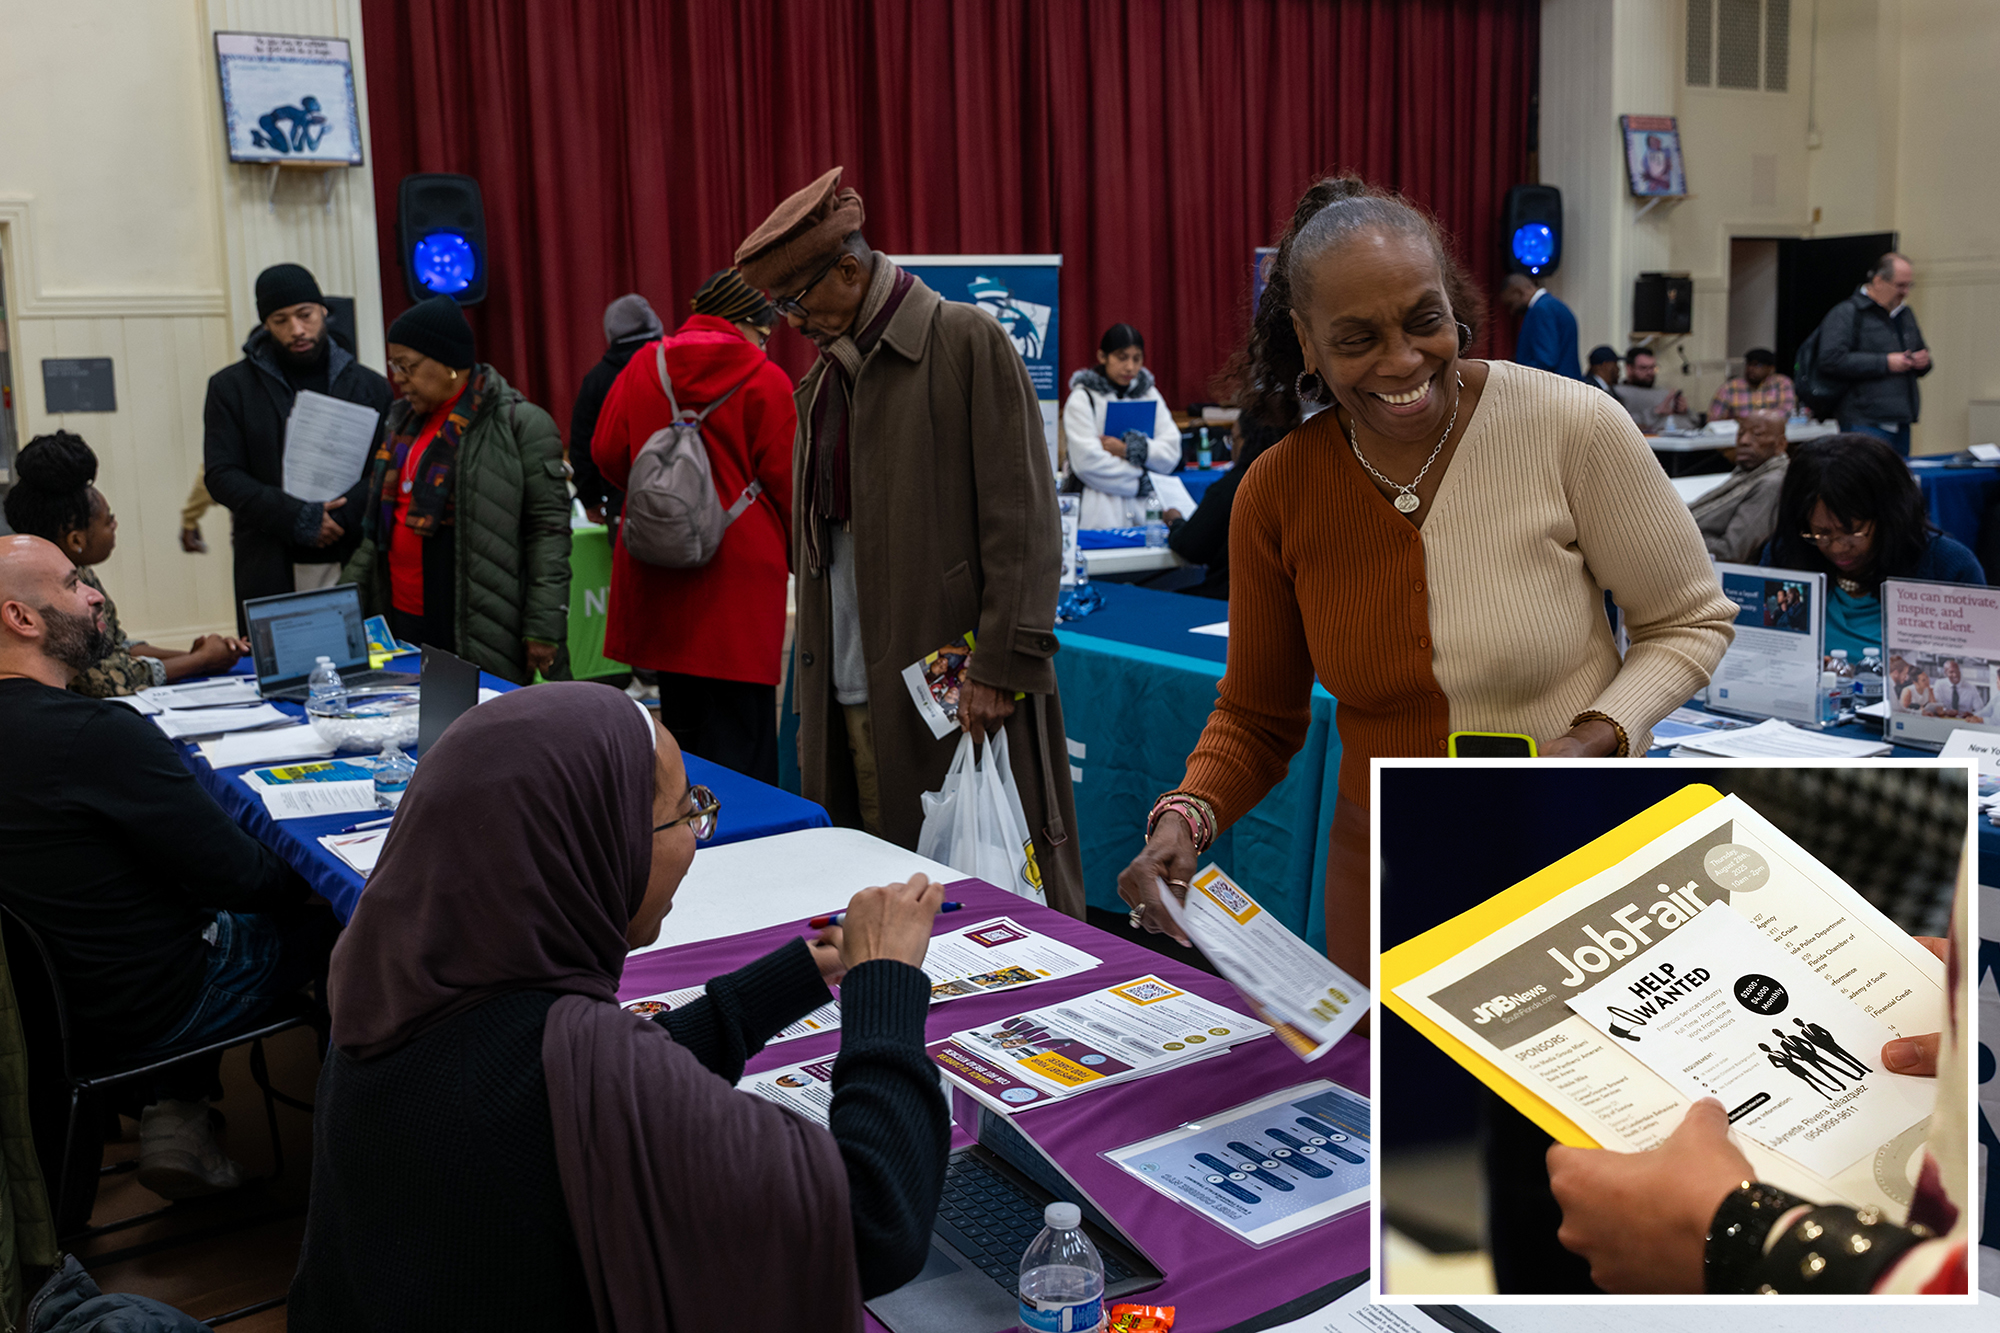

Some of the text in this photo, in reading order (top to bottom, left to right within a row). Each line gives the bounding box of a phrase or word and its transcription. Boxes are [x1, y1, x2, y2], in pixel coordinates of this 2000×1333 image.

[585, 586, 610, 618] N
[1897, 588, 1998, 609] You can motivate,
[1897, 602, 1963, 618] inspire, and
[1897, 617, 1974, 633] attract talent.
[1968, 744, 1988, 753] New
[1709, 848, 1739, 867] Thursday,
[1712, 851, 1752, 877] August 28th,
[1730, 863, 1749, 876] 2025
[1730, 875, 1750, 888] 10am
[1748, 864, 1767, 877] 2pm
[1751, 912, 1764, 922] #27
[1755, 914, 1778, 930] Agency
[1546, 880, 1709, 988] JobFair
[1767, 926, 1779, 934] #11
[1779, 923, 1798, 937] Cruise
[1798, 935, 1817, 948] Police
[1813, 916, 1847, 939] Department
[1783, 940, 1793, 948] #3
[1806, 952, 1828, 967] Florida
[1824, 937, 1850, 955] Chamber
[1800, 952, 1813, 961] #39
[1628, 963, 1675, 999] HELP
[1869, 970, 1888, 983] South
[1635, 967, 1711, 1020] WANTED
[1740, 981, 1758, 998] $2000
[1751, 985, 1769, 1004] $4,000
[1761, 987, 1784, 1011] Monthly
[1872, 987, 1913, 1016] Financial Credit
[1654, 987, 1724, 1032] Financial Services Industry
[1673, 1026, 1687, 1035] Full
[1683, 1018, 1699, 1029] Time
[1699, 1008, 1714, 1018] Part
[1710, 999, 1727, 1011] Time
[1685, 1007, 1733, 1039] Work From Home
[1697, 1016, 1737, 1043] Flexible Hours
[1515, 1033, 1569, 1061] SPONSORS:
[1800, 1107, 1831, 1126] Rivera
[1824, 1083, 1871, 1112] Velazquez
[1800, 1104, 1862, 1142] (954)899-9611
